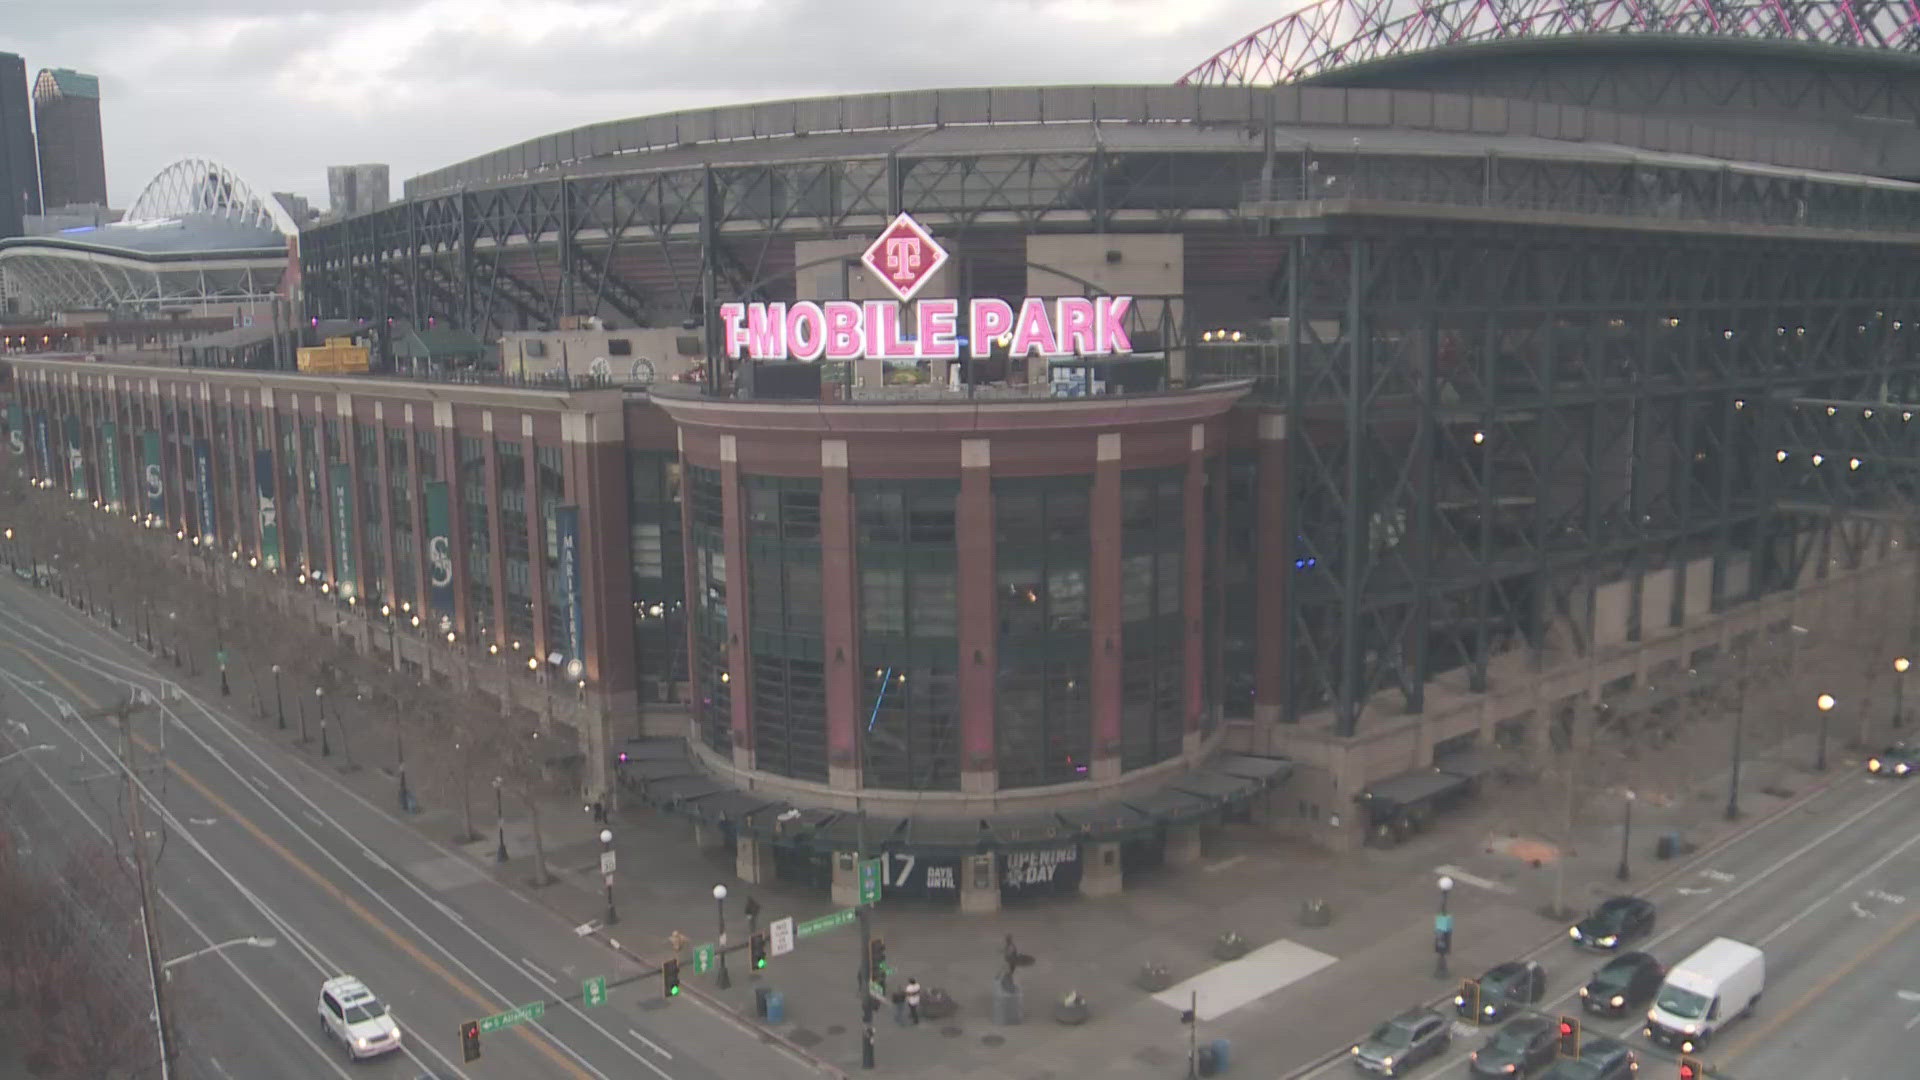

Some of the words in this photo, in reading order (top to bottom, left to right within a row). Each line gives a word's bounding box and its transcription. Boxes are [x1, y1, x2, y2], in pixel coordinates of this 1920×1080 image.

[887, 237, 921, 280] T
[720, 299, 960, 361] T-MOBILE
[969, 297, 1133, 358] PARK
[563, 535, 577, 645] MARINERS
[881, 851, 915, 888] 17
[1007, 845, 1077, 867] OPENING
[927, 866, 954, 878] DAYS
[927, 877, 956, 889] UNTIL
[1025, 865, 1057, 884] DAY
